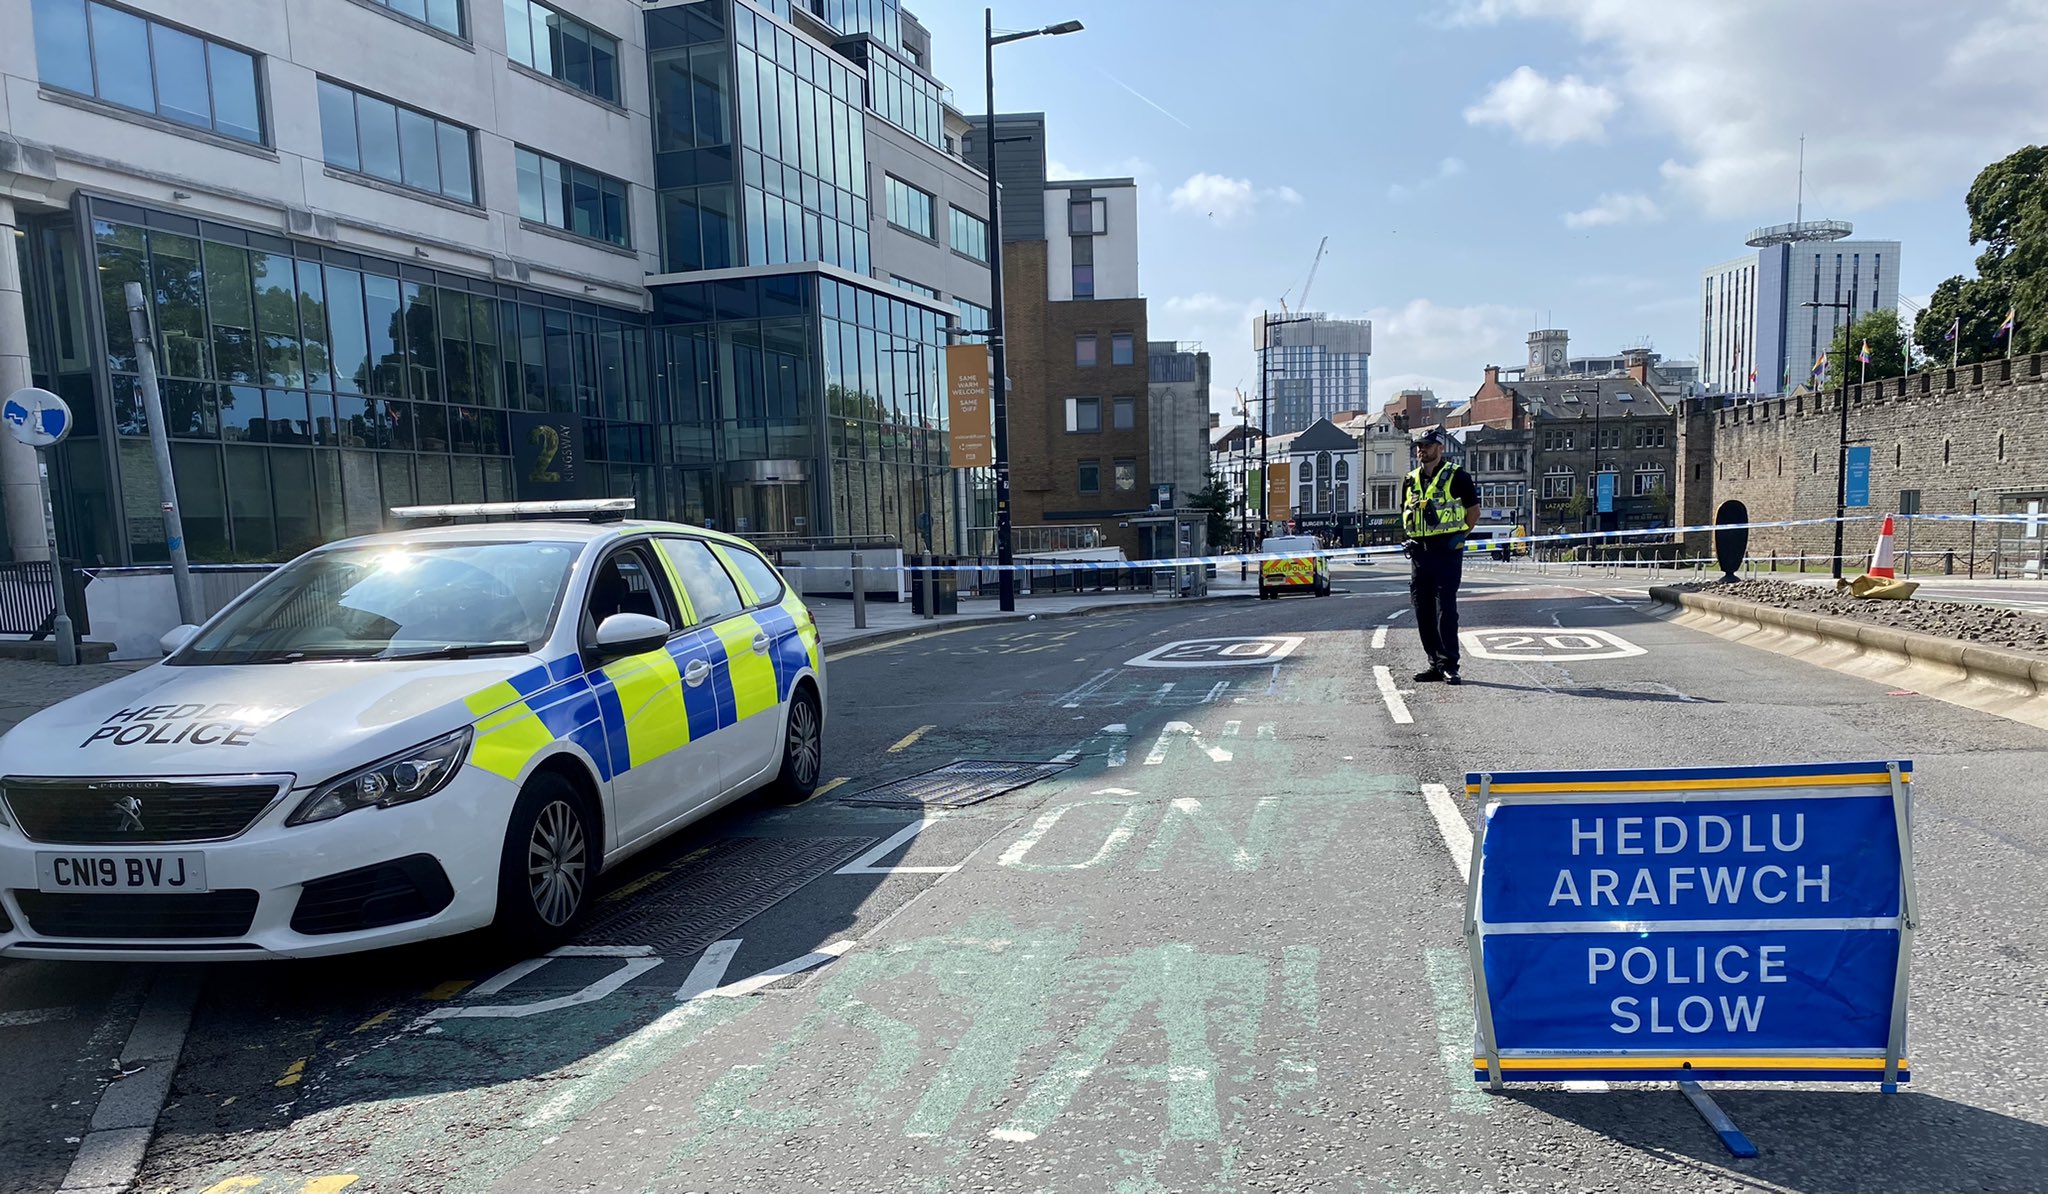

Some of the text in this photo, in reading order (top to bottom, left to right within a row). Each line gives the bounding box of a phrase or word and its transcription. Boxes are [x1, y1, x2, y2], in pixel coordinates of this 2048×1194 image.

[528, 424, 575, 482] 2 KINGSWAY
[1368, 518, 1399, 526] SUBWAY
[1162, 642, 1276, 658] 20
[1486, 635, 1604, 650] 20
[101, 702, 248, 725] HEDD
[78, 722, 257, 749] POLICE
[1571, 813, 1805, 856] HEDDLU
[53, 857, 186, 887] CN19 BVJ
[1548, 864, 1830, 906] ARAFWCH
[1588, 945, 1787, 985] POLICE
[1610, 995, 1766, 1034] SLOW
